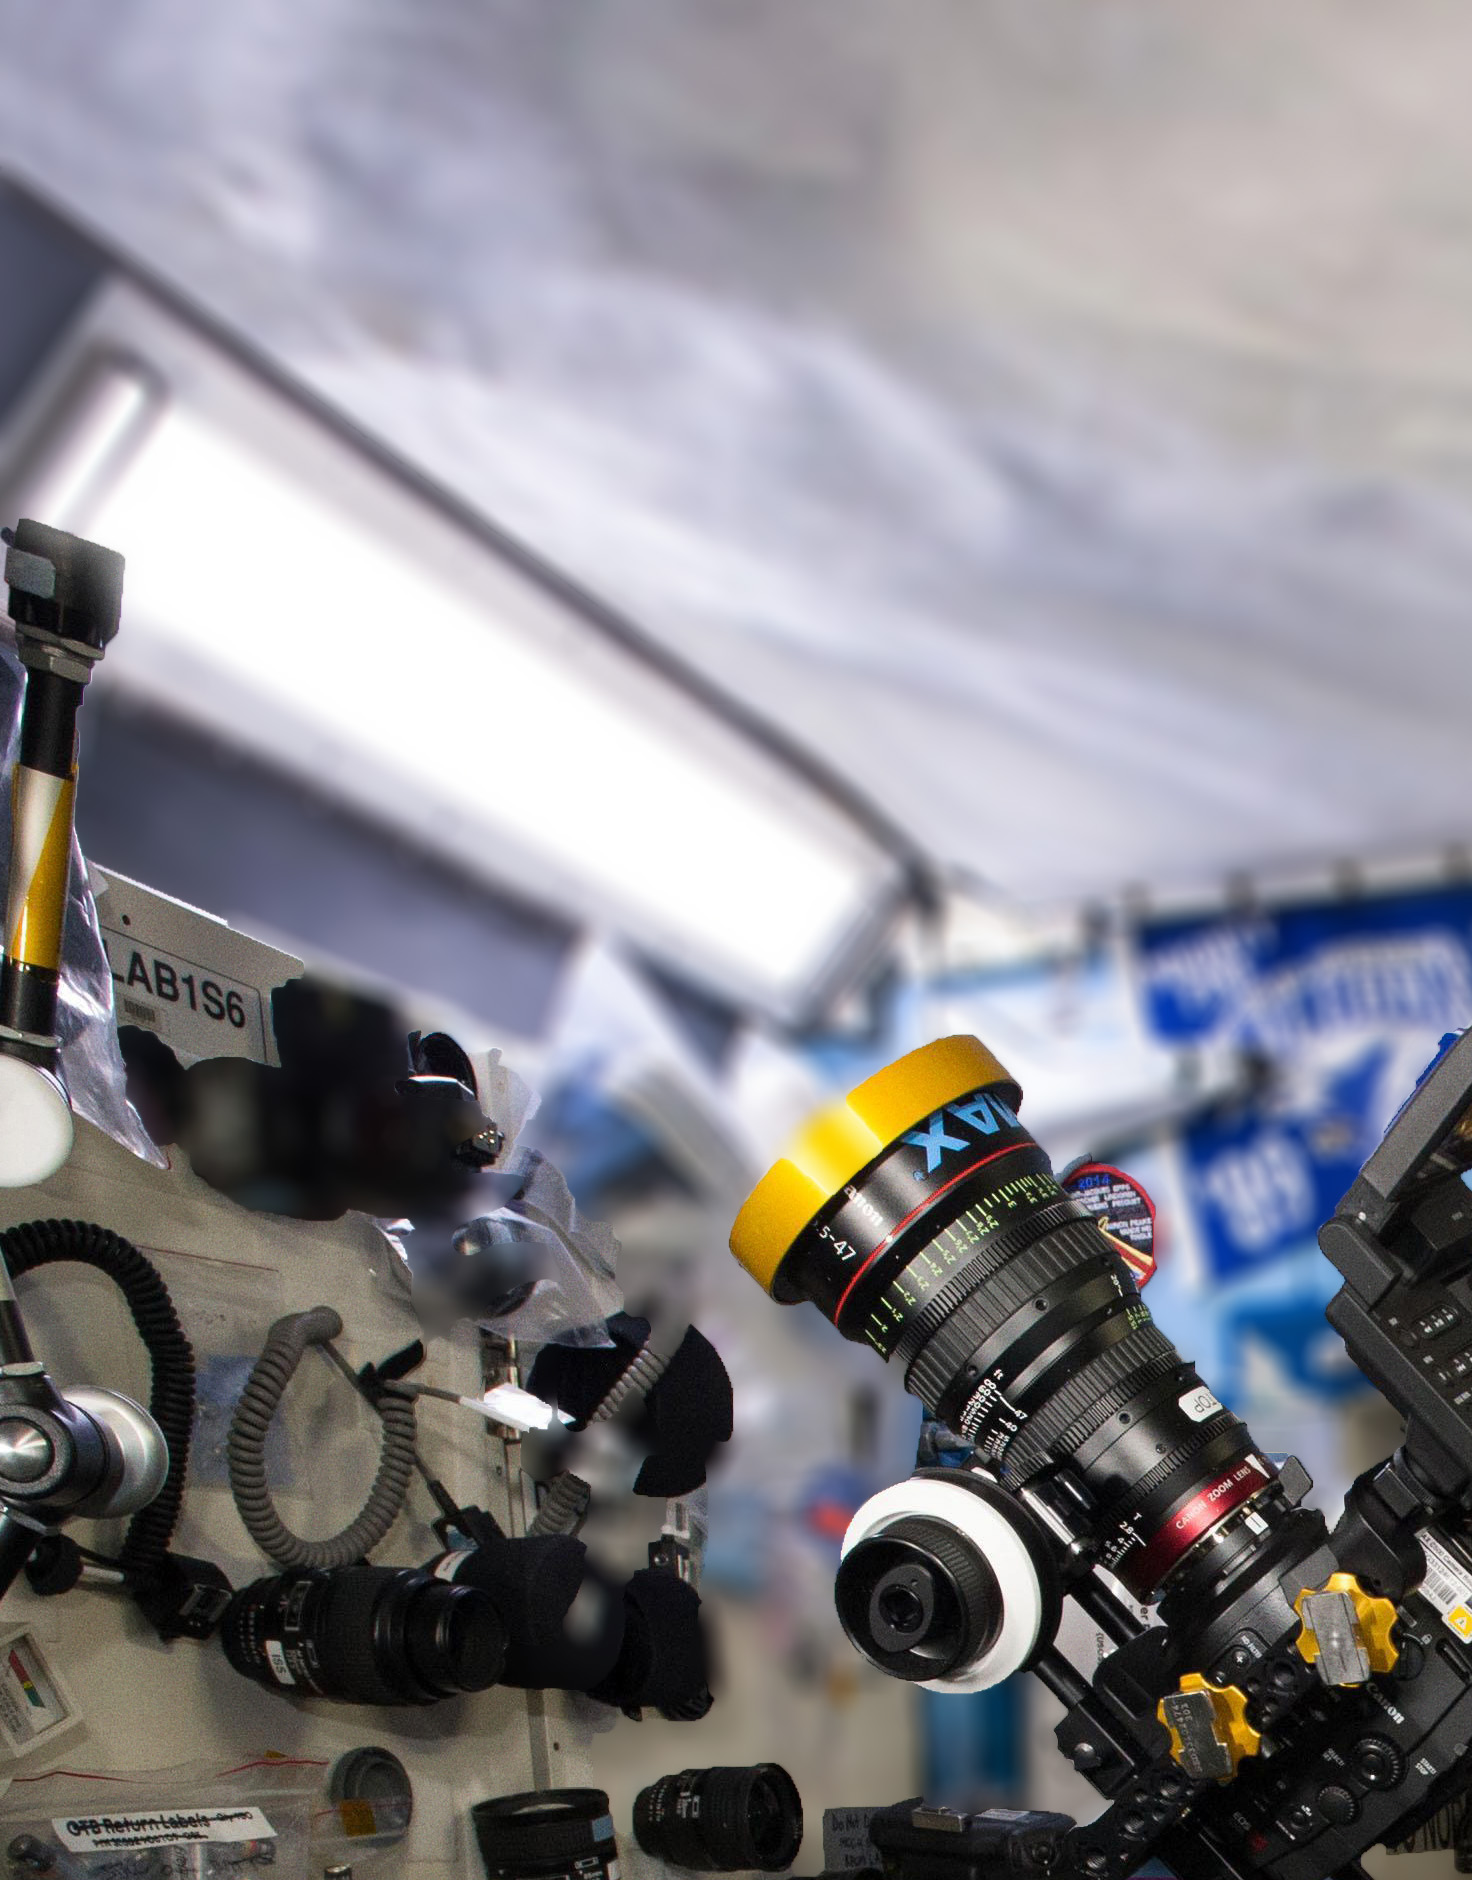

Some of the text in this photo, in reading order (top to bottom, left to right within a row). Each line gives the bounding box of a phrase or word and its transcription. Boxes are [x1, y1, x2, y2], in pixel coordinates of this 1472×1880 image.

[844, 1185, 883, 1226] anon
[1175, 1465, 1252, 1530] CANON ZOOM LENS
[1366, 1681, 1405, 1725] Canon
